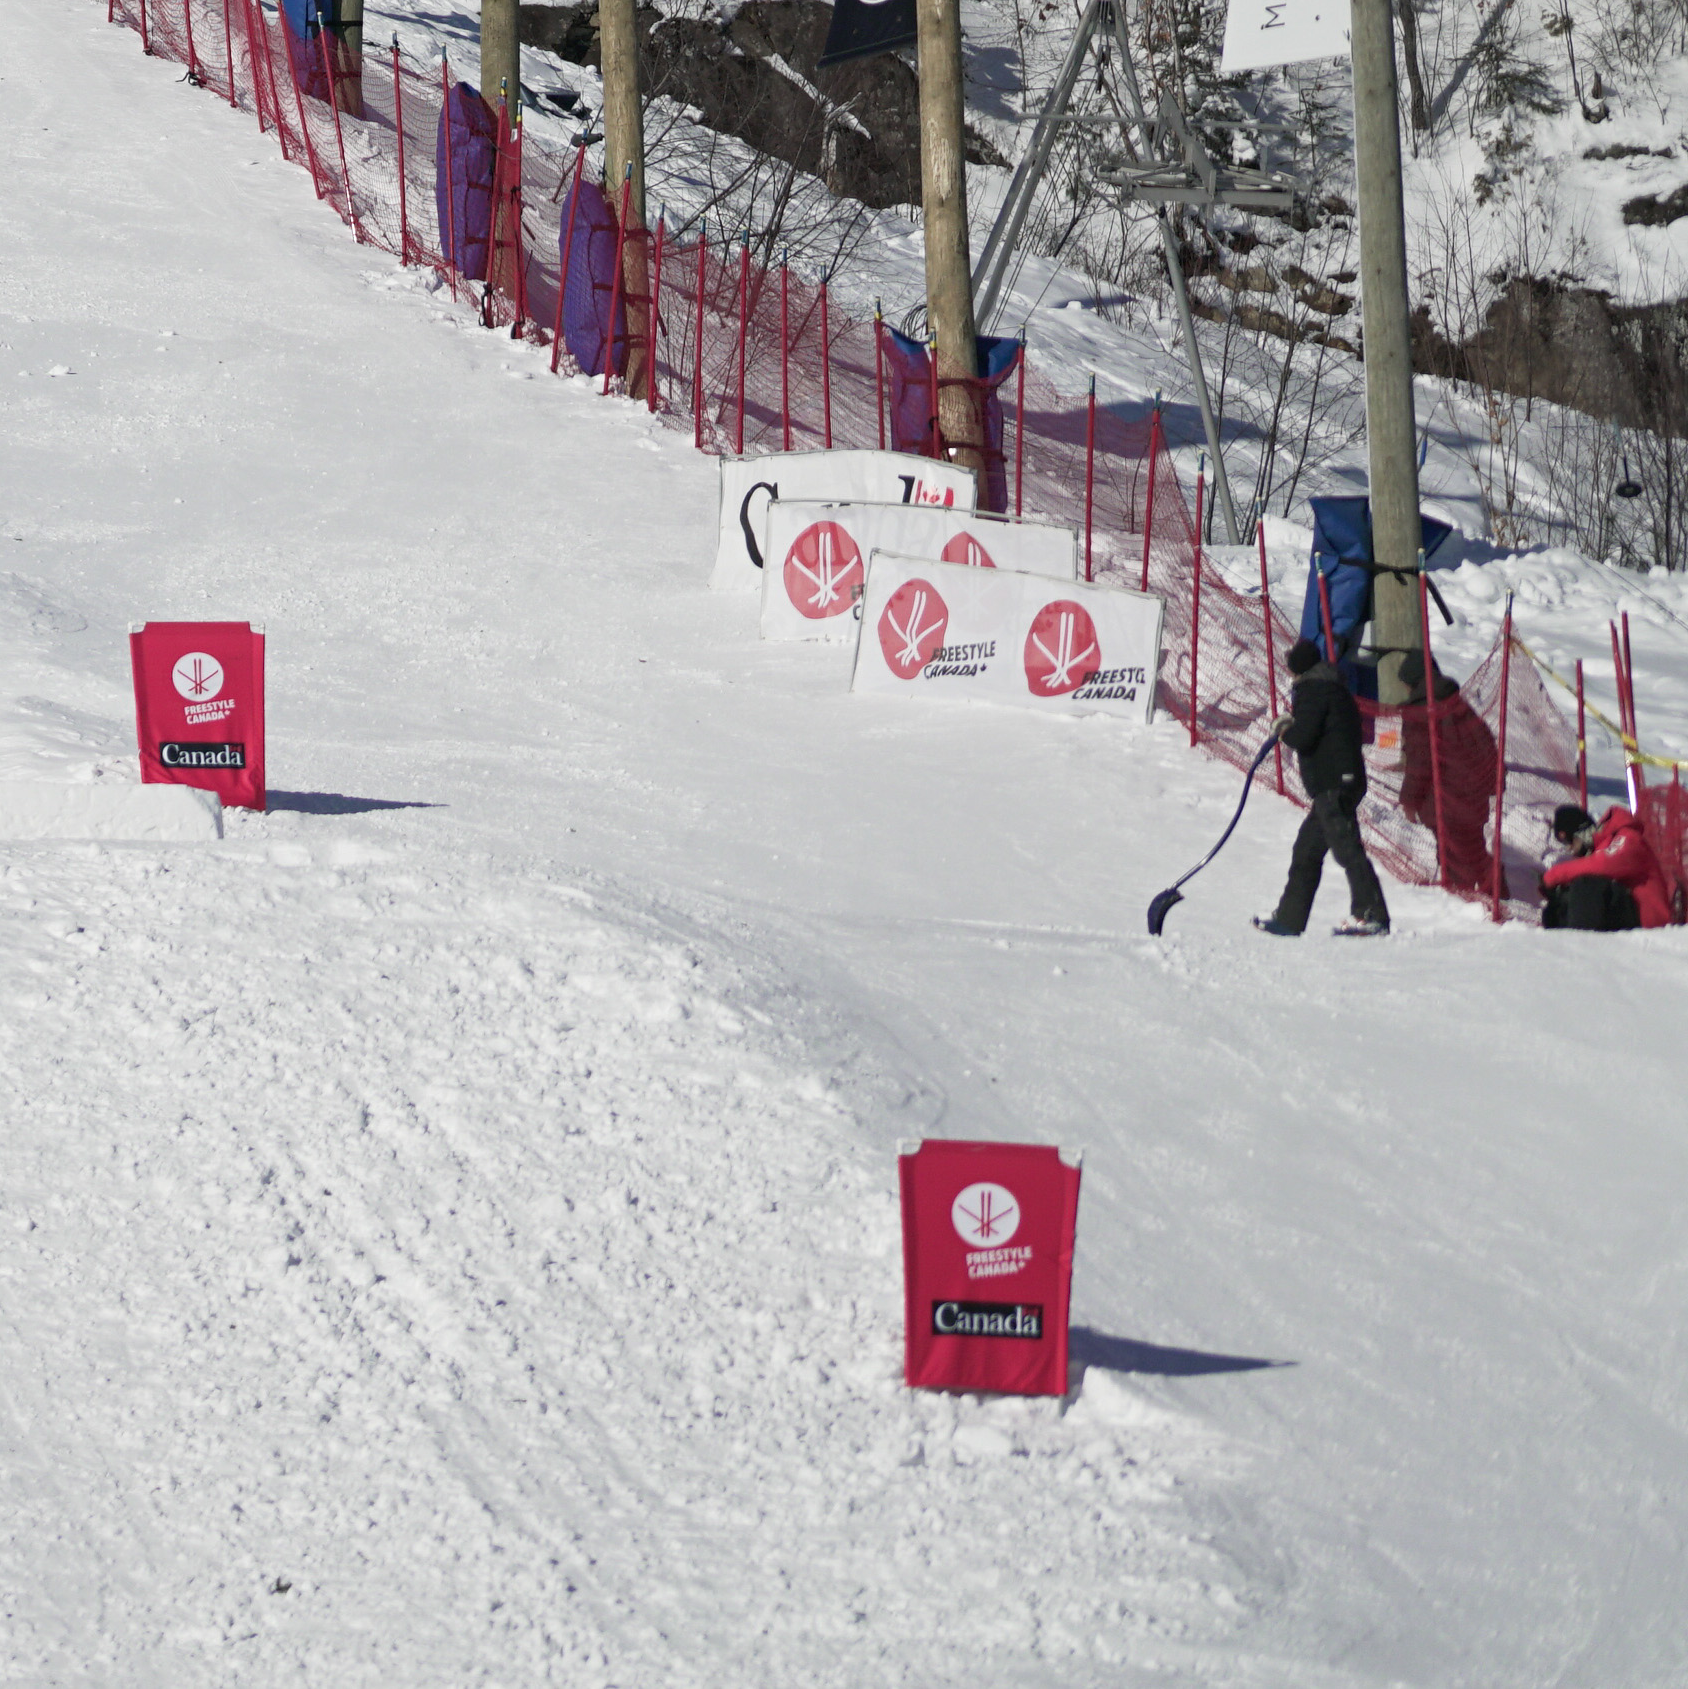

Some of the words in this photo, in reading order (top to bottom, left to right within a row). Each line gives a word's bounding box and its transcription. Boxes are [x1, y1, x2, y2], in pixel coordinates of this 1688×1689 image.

[930, 639, 997, 663] FREESTYLE
[923, 663, 979, 680] CANADA
[1071, 685, 1137, 702] CANADA
[184, 699, 236, 716] FREESTYLE
[186, 711, 225, 725] CANADA
[161, 743, 244, 766] Canada
[965, 1245, 1033, 1266] FREESTYLE
[968, 1260, 1019, 1280] CANADA
[934, 1301, 1041, 1336] Canada
